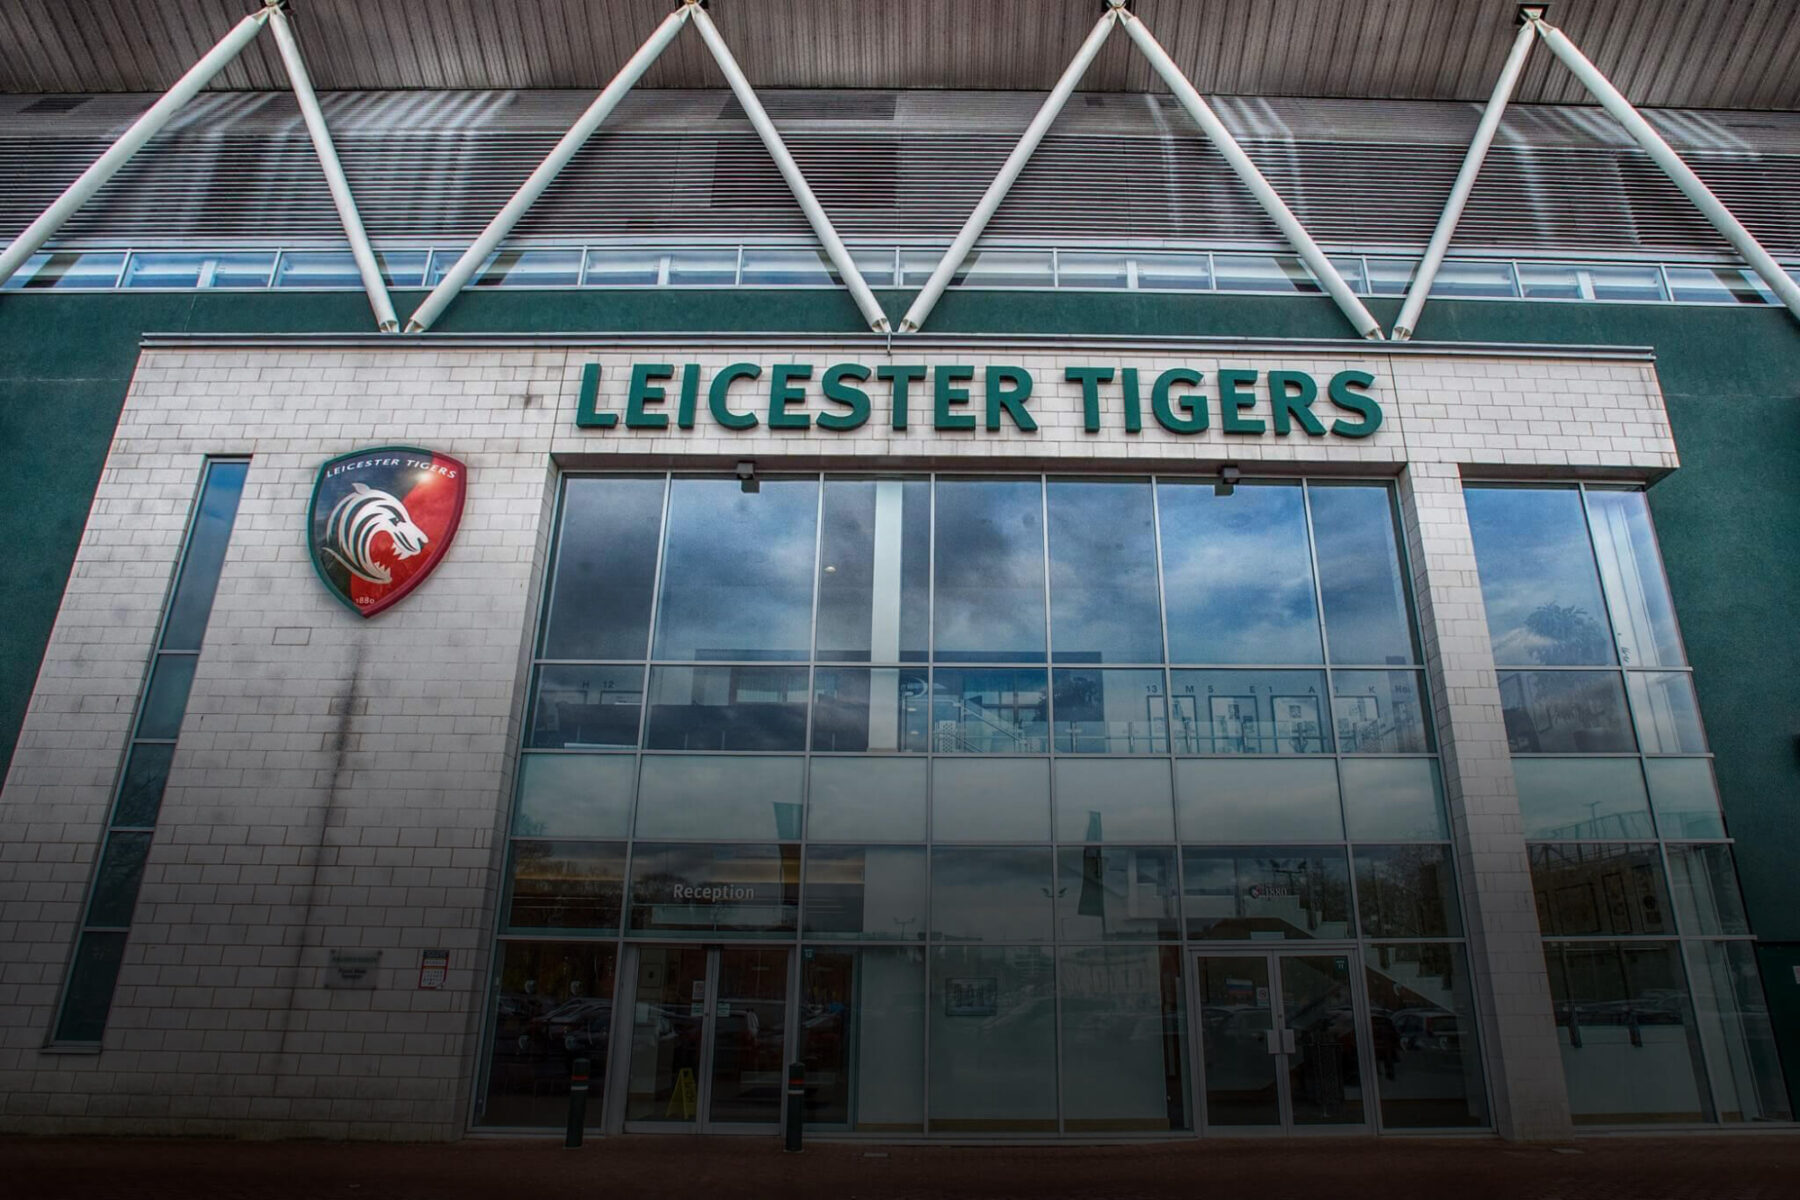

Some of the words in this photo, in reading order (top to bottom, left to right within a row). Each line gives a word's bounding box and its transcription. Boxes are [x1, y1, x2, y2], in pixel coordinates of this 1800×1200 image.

[576, 362, 1038, 432] LEICESTER
[1064, 366, 1383, 438] TIGERS
[326, 458, 400, 478] LEICESTER
[406, 459, 457, 479] TIGERS
[1146, 685, 1158, 693] 13
[1185, 685, 1194, 693] M
[673, 884, 755, 902] Reception
